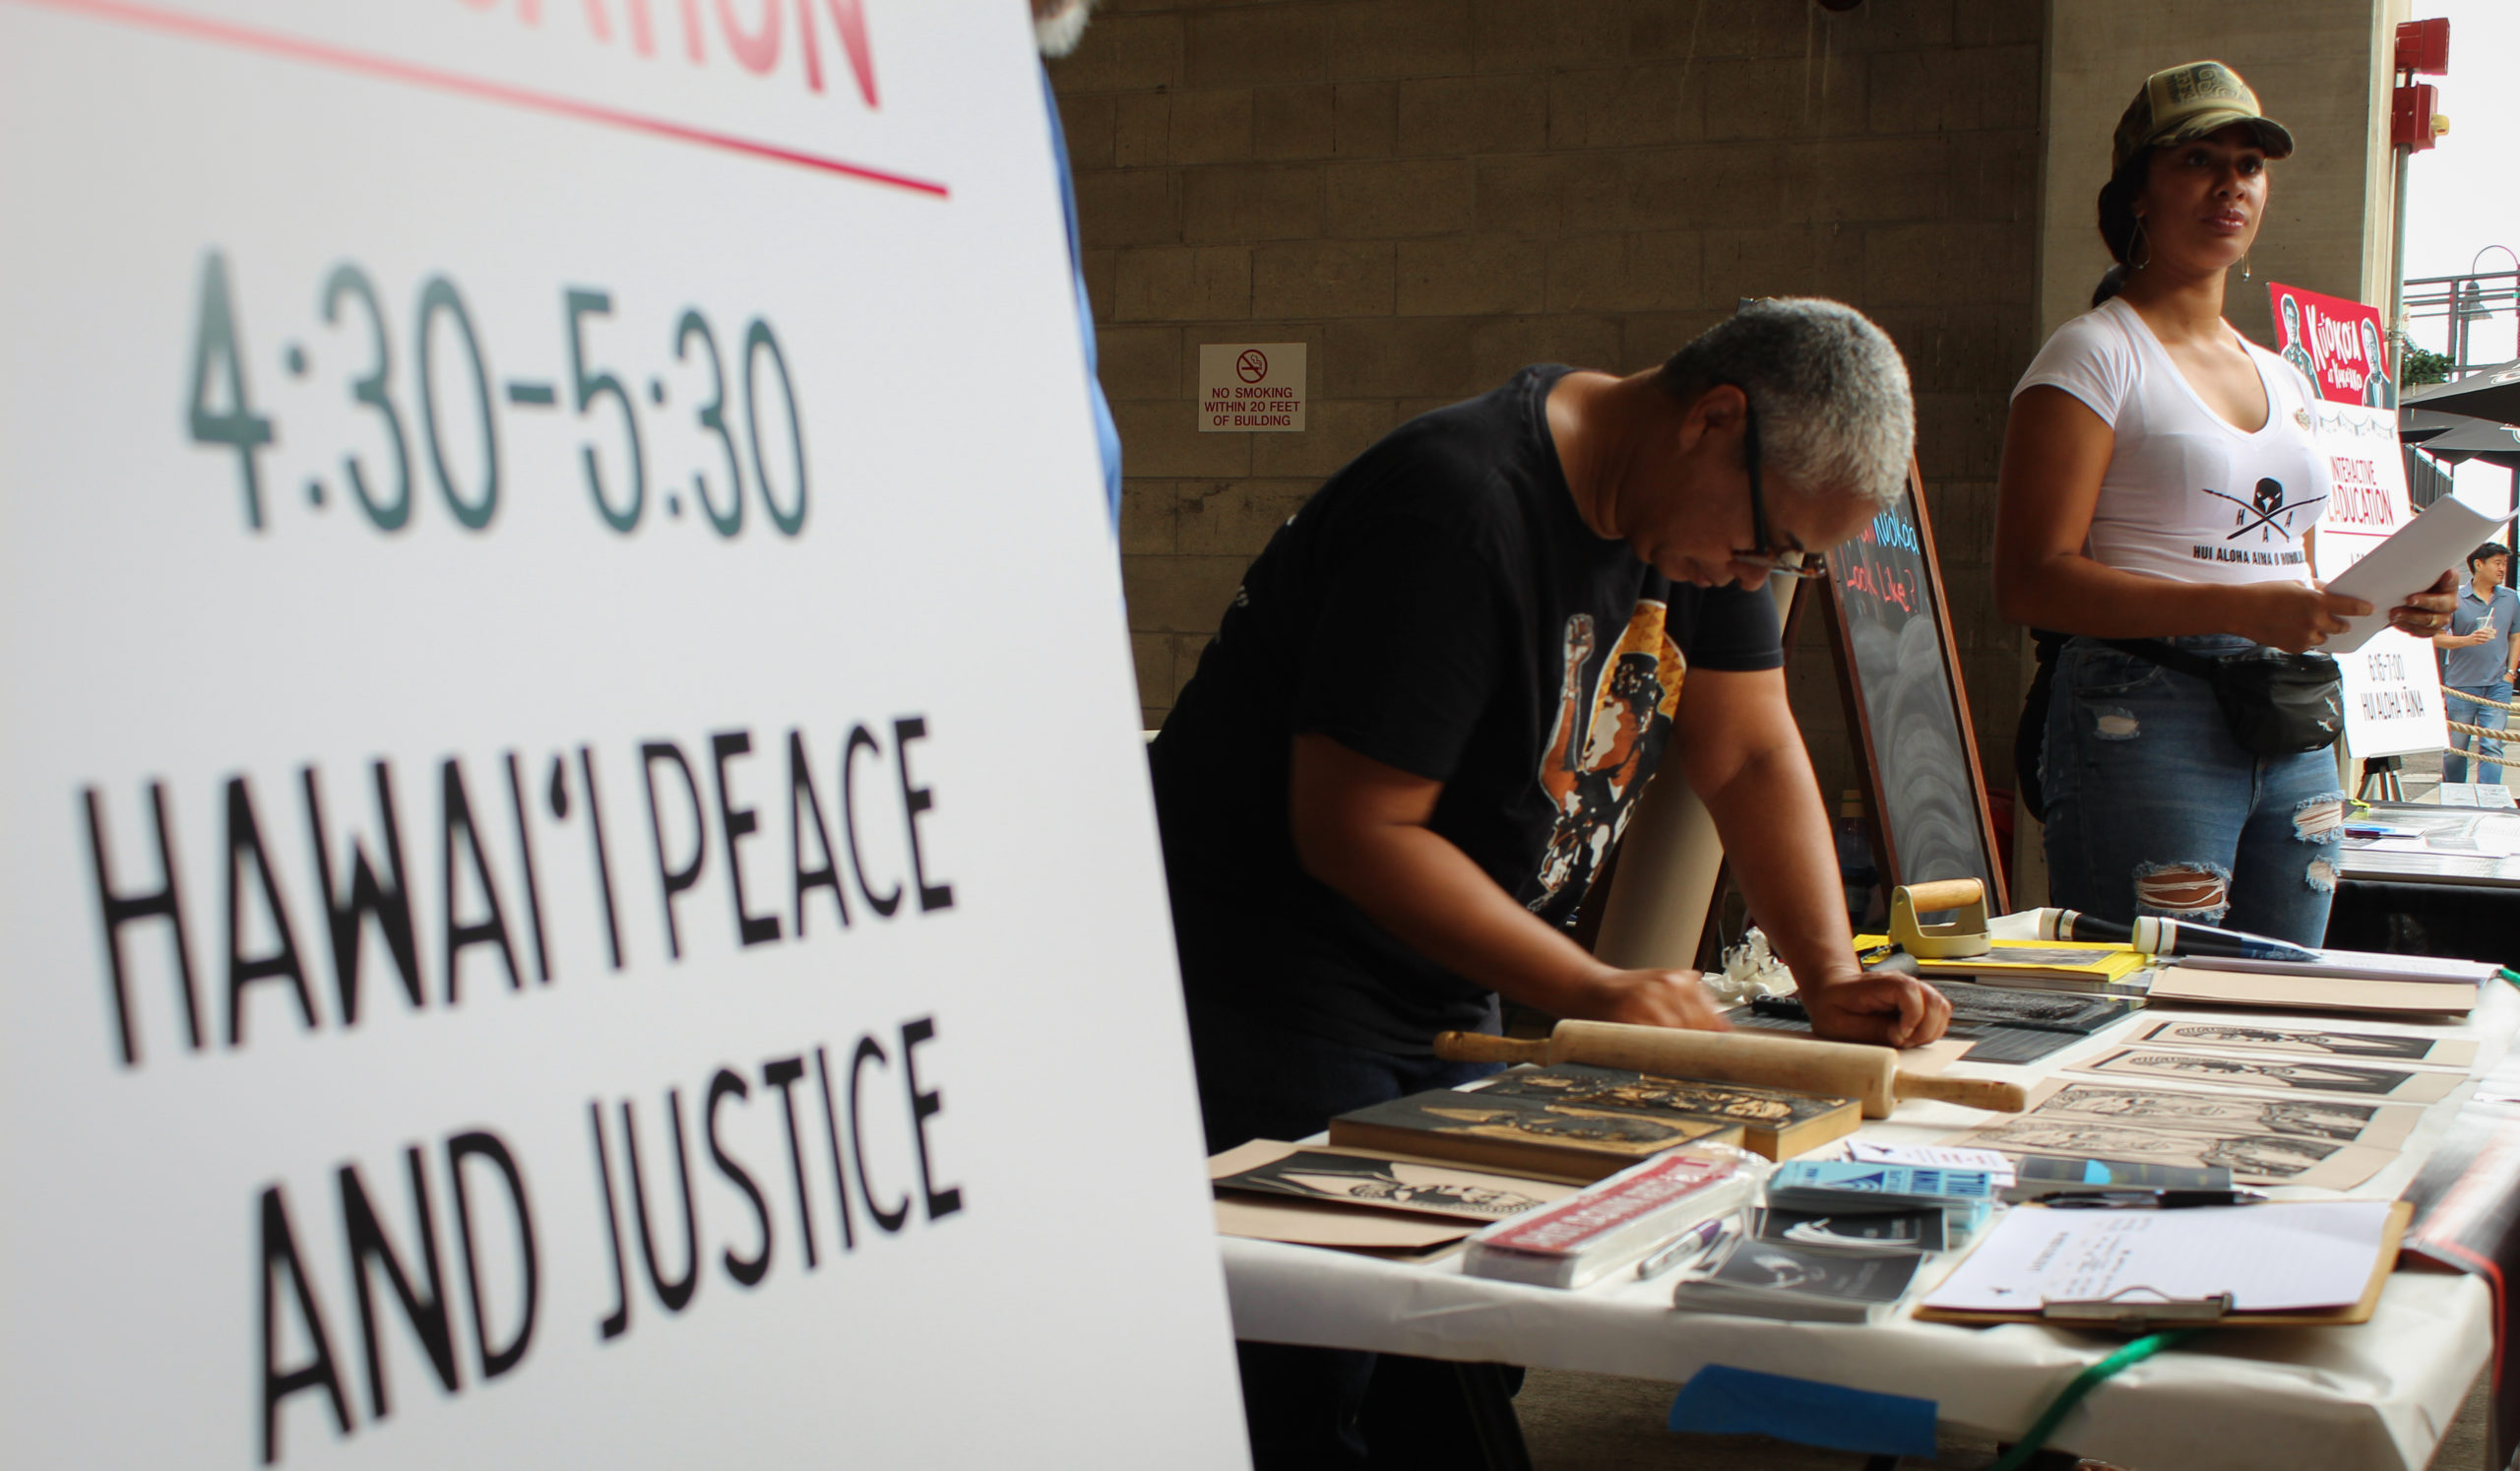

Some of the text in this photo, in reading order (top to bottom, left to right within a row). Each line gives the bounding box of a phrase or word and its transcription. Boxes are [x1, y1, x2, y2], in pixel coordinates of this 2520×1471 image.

[185, 246, 809, 538] 4:30-5:30
[1205, 401, 1300, 412] WITHIN 20 FEET
[1212, 387, 1292, 399] NO SMOKING
[1213, 415, 1292, 426] OF BUILDING
[2329, 456, 2377, 485] INTERACTIVE
[2192, 545, 2213, 560] HUI
[2216, 547, 2250, 564] ALOHA
[2361, 691, 2376, 722] HUI
[2375, 691, 2403, 721] ALOHA
[82, 715, 956, 1069] HAWAI'I PEACE
[250, 1014, 967, 1469] AND JUSTICE
